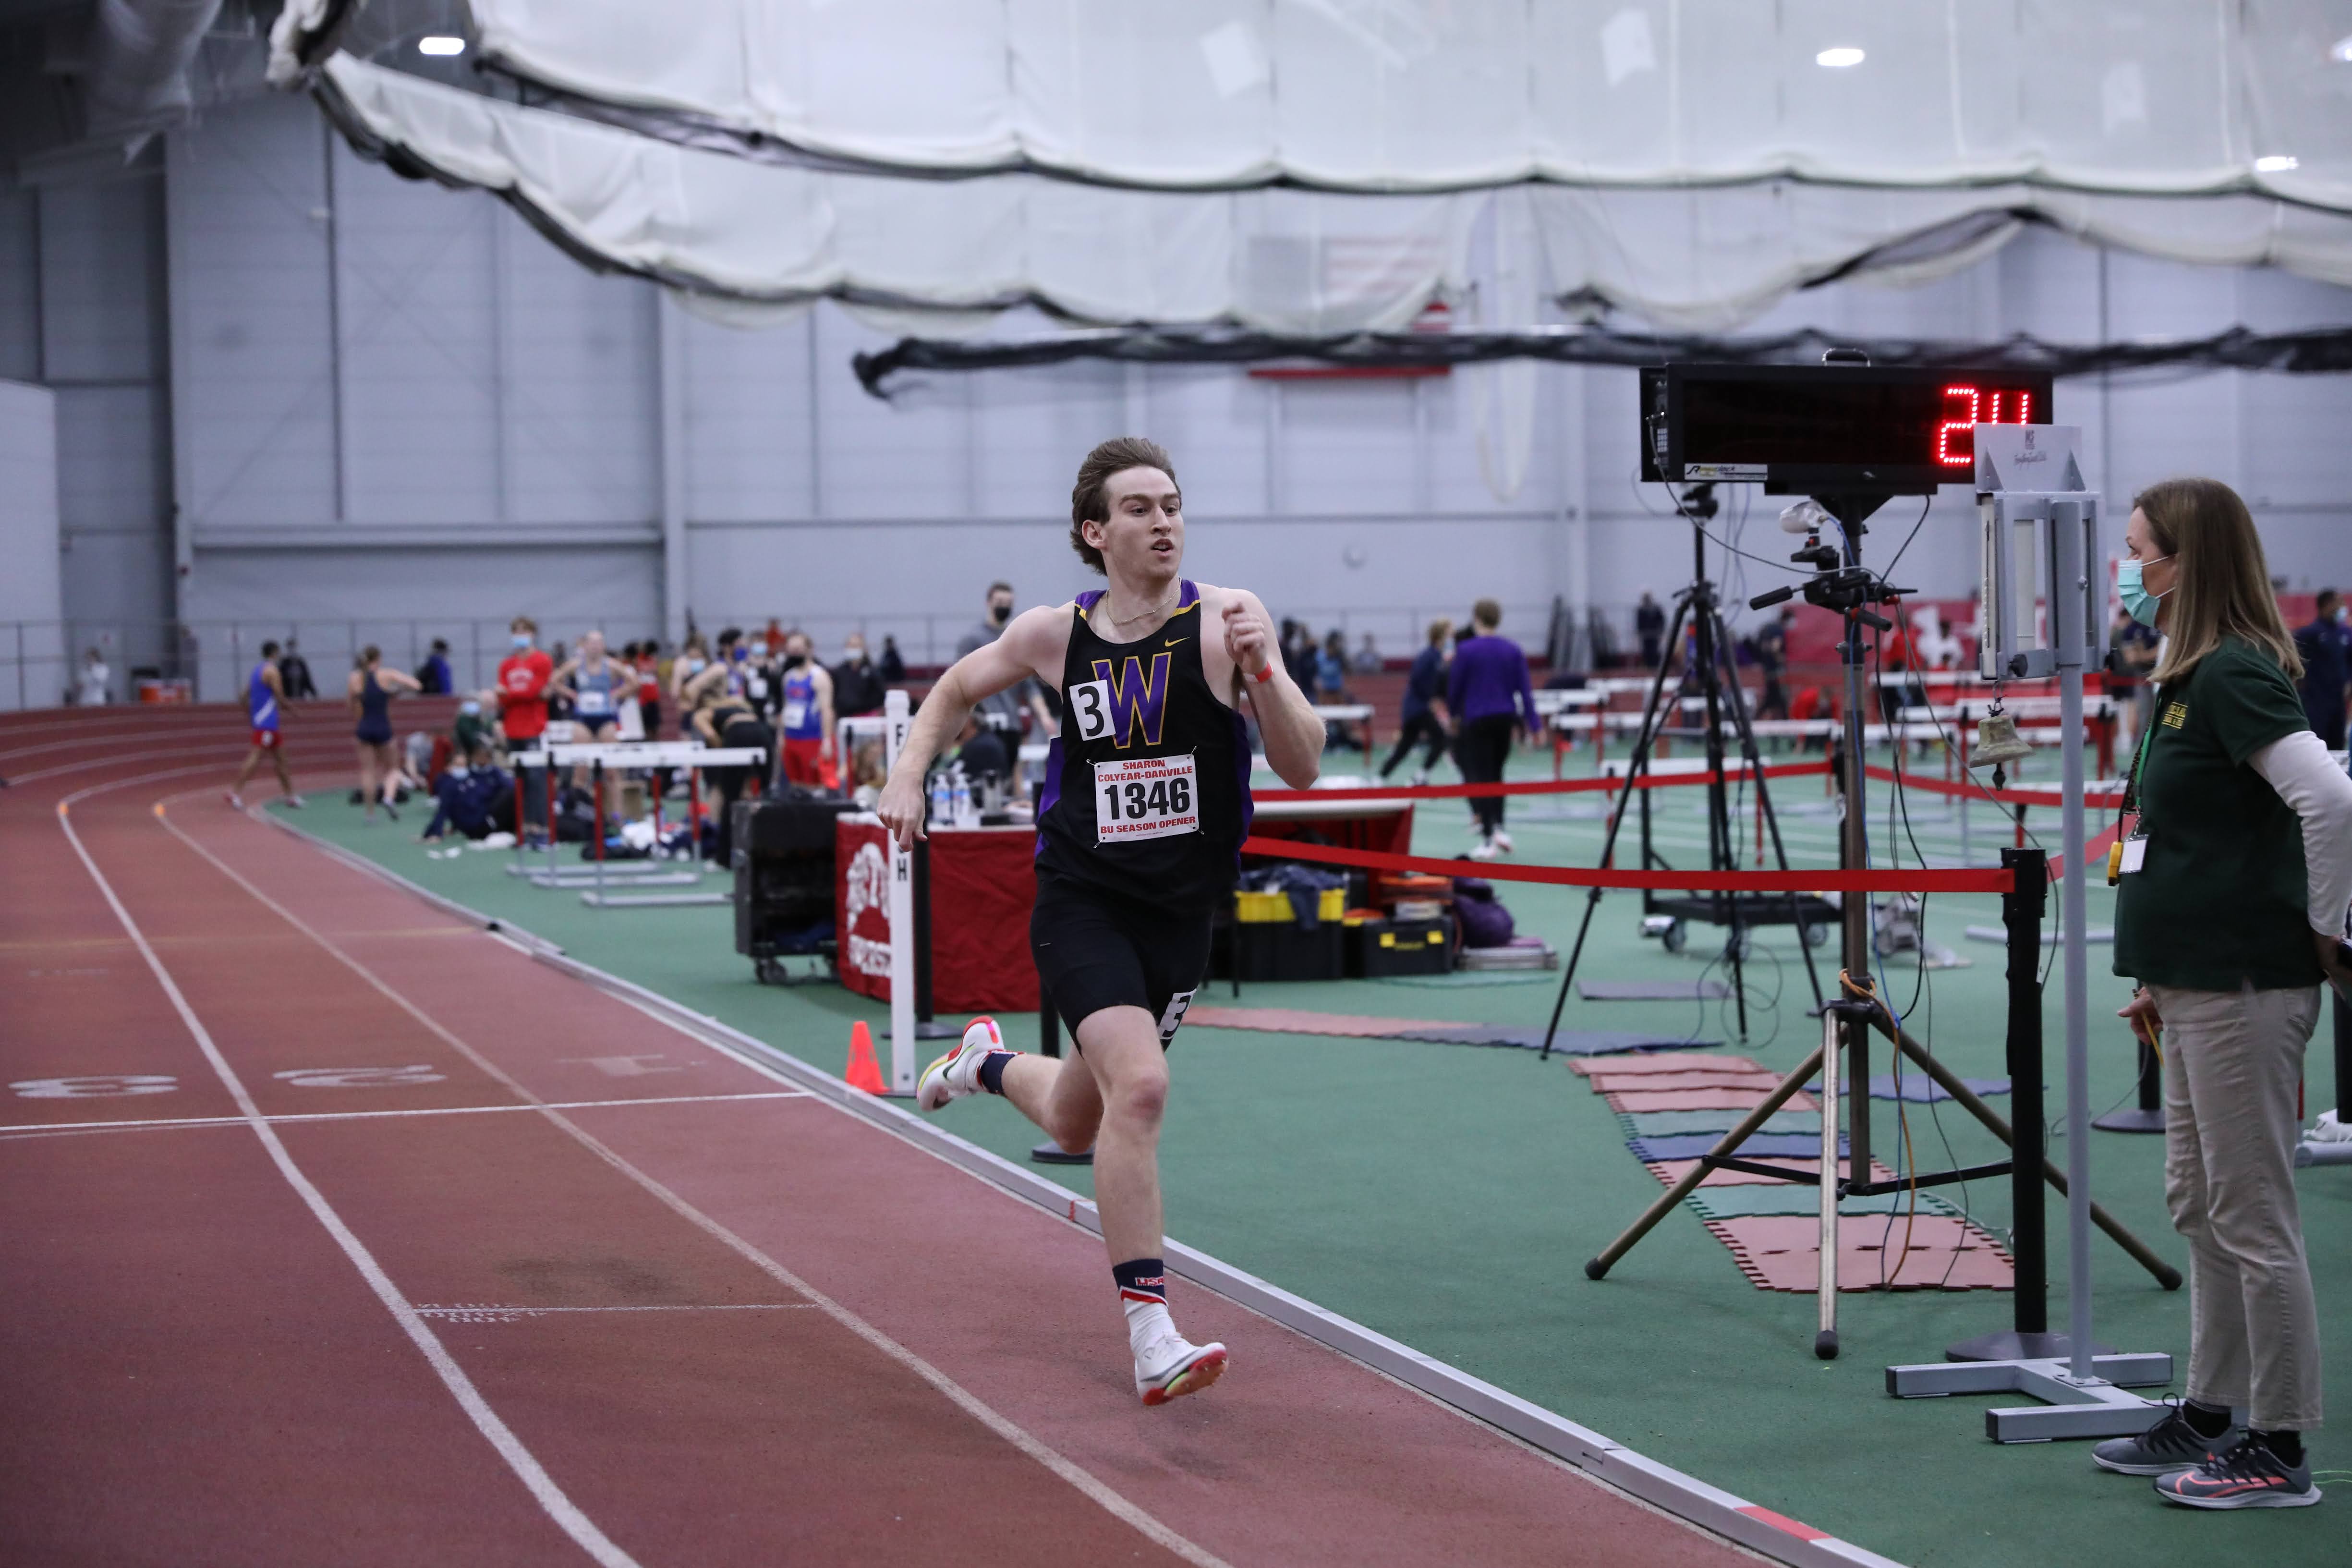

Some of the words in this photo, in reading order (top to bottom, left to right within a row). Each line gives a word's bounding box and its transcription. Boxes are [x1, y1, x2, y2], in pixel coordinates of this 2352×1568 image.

[1078, 686, 1104, 737] 3
[1091, 652, 1172, 749] W
[1098, 766, 1193, 782] COLYEAR-DANVILLE
[1122, 759, 1165, 770] SHARON
[1104, 778, 1190, 820] 1346
[1100, 826, 1114, 834] BU
[1116, 822, 1156, 832] SEASON
[1159, 816, 1196, 828] OPENER
[1162, 995, 1191, 1038] 3
[8, 1076, 180, 1098] 3
[273, 1064, 448, 1087] 2
